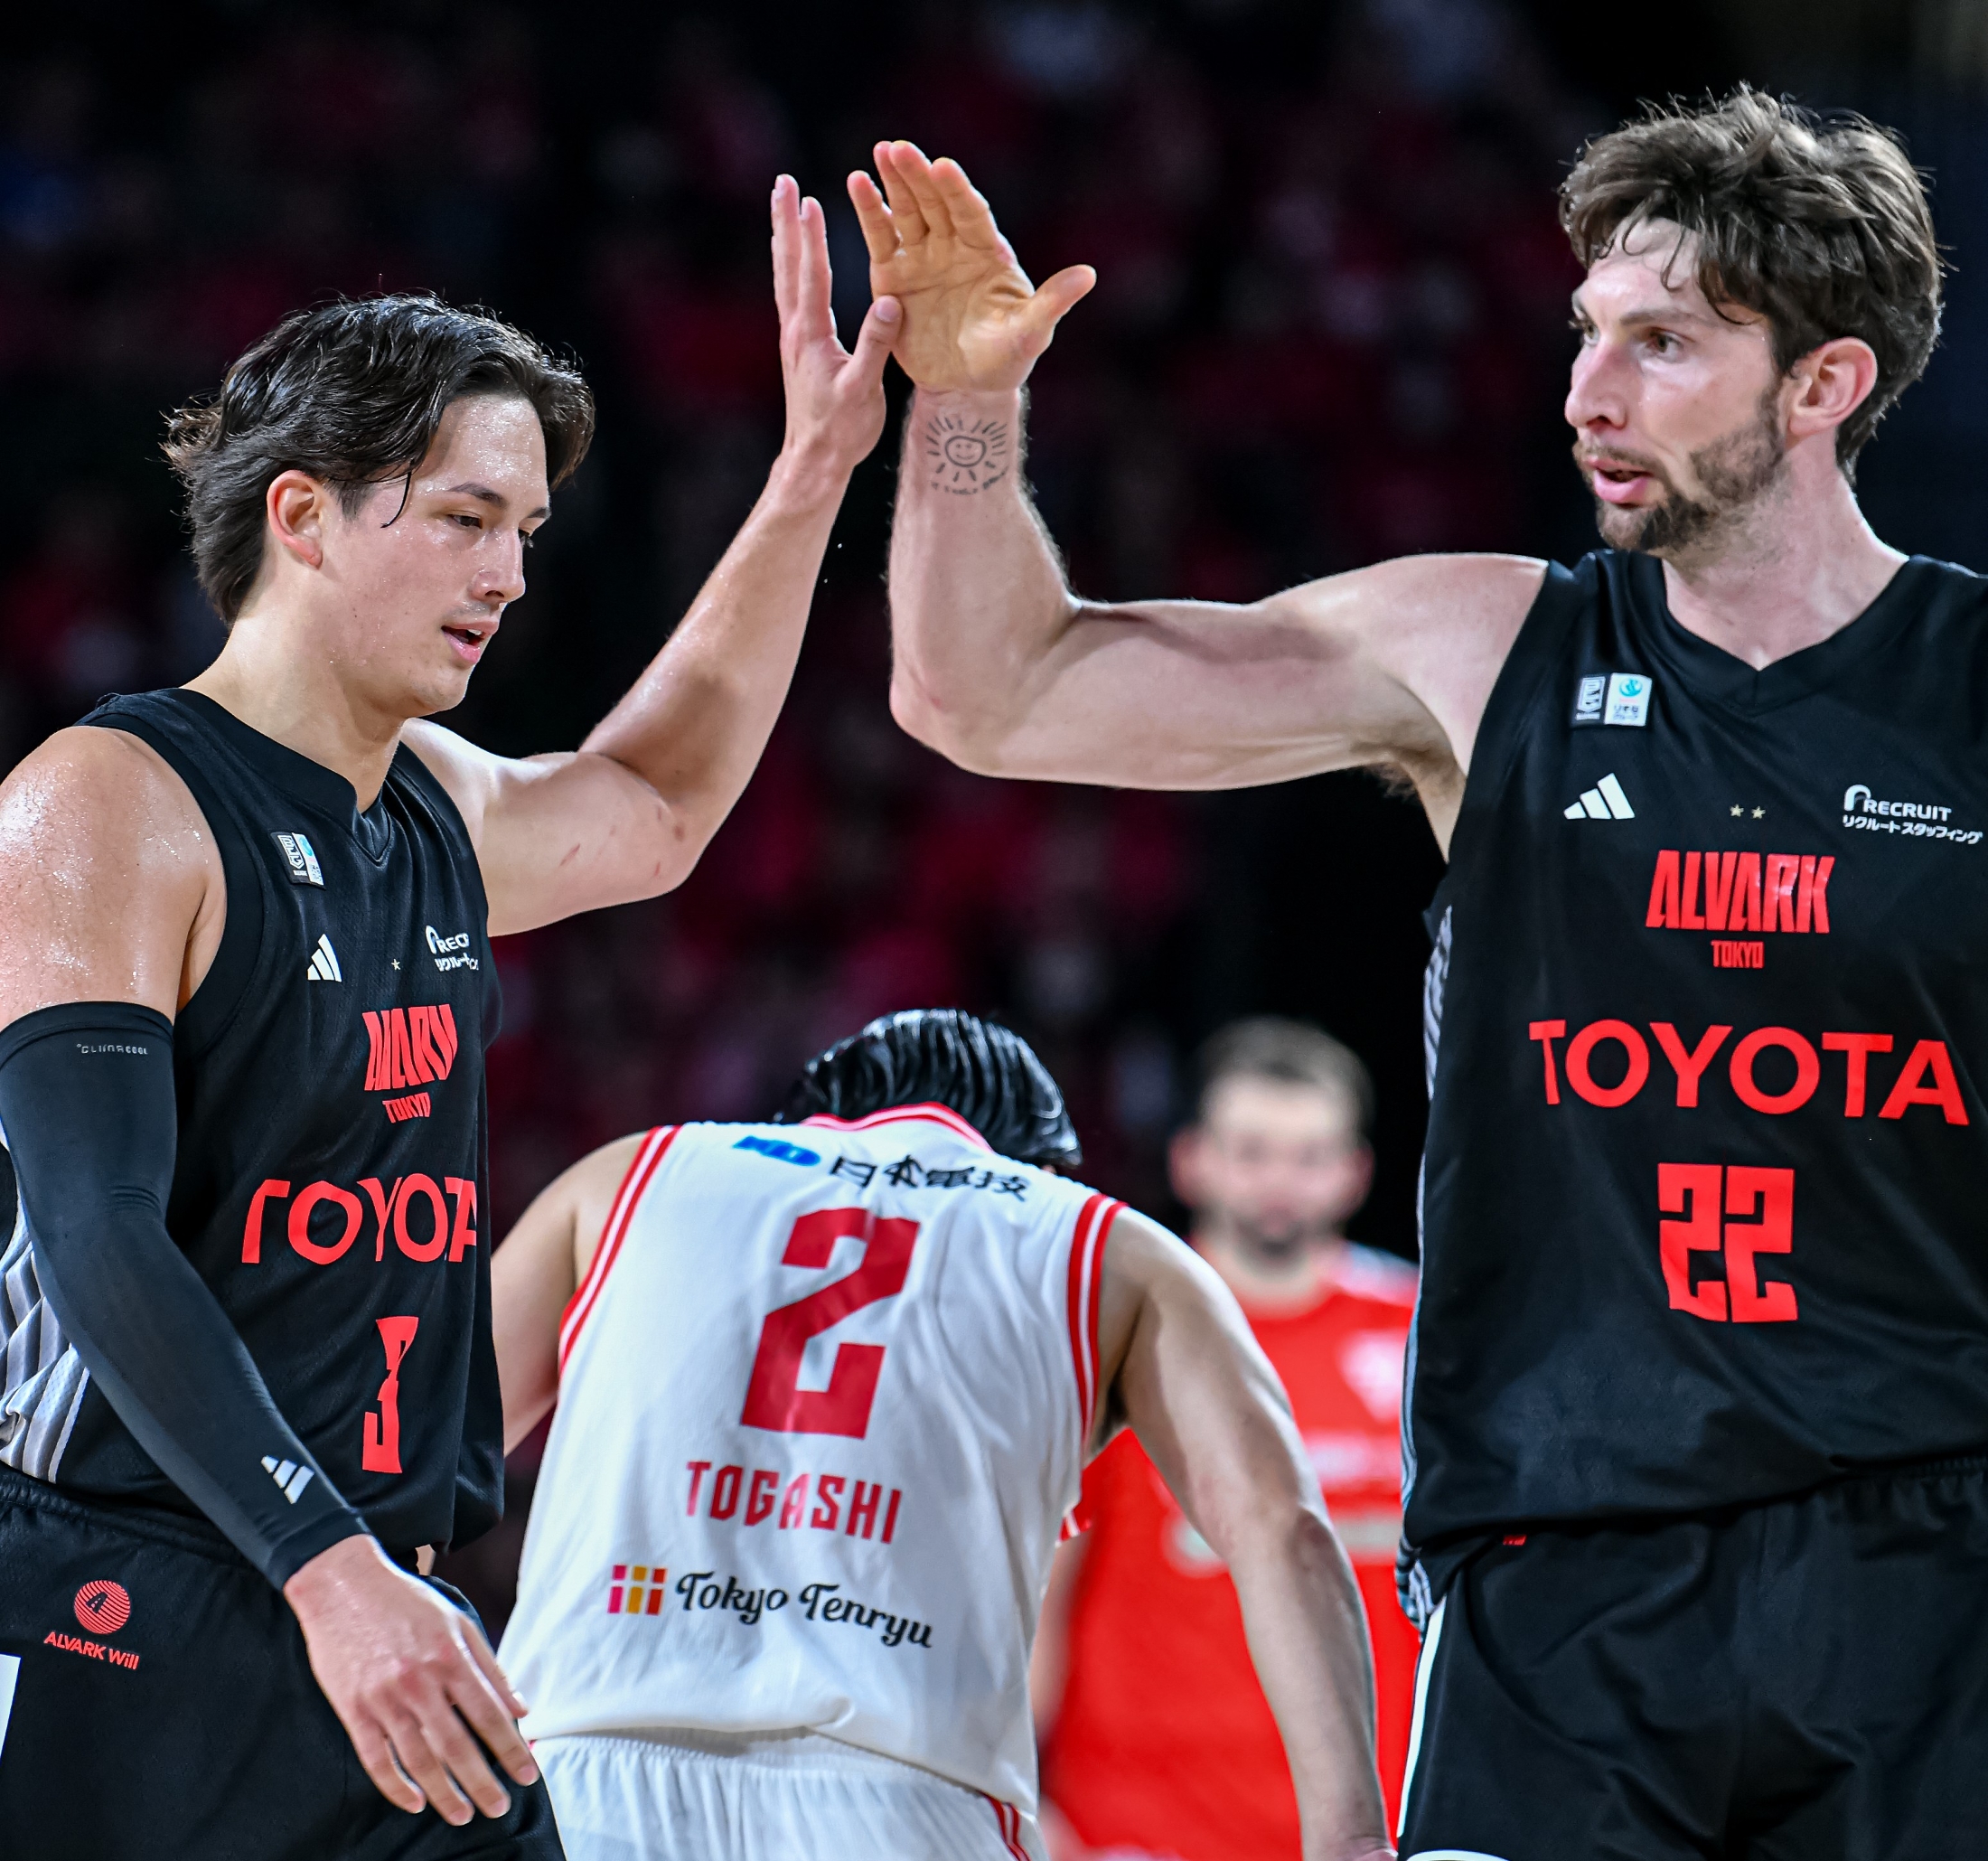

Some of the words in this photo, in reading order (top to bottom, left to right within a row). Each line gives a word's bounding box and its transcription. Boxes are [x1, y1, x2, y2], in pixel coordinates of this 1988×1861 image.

[1862, 798, 1953, 822] RECRUIT
[1646, 850, 1835, 934] ALVARK
[1711, 939, 1765, 969] TOKYO
[381, 1092, 431, 1123] TOKYO
[1529, 1018, 1970, 1125] TOYOTA
[1657, 1162, 1798, 1323] 22
[740, 1207, 920, 1440] 2
[686, 1461, 902, 1544] TOGASHI
[43, 1631, 107, 1660] ALVARK
[108, 1648, 140, 1670] Will
[676, 1572, 789, 1625] Tokyo
[798, 1584, 933, 1649] Tenryu
